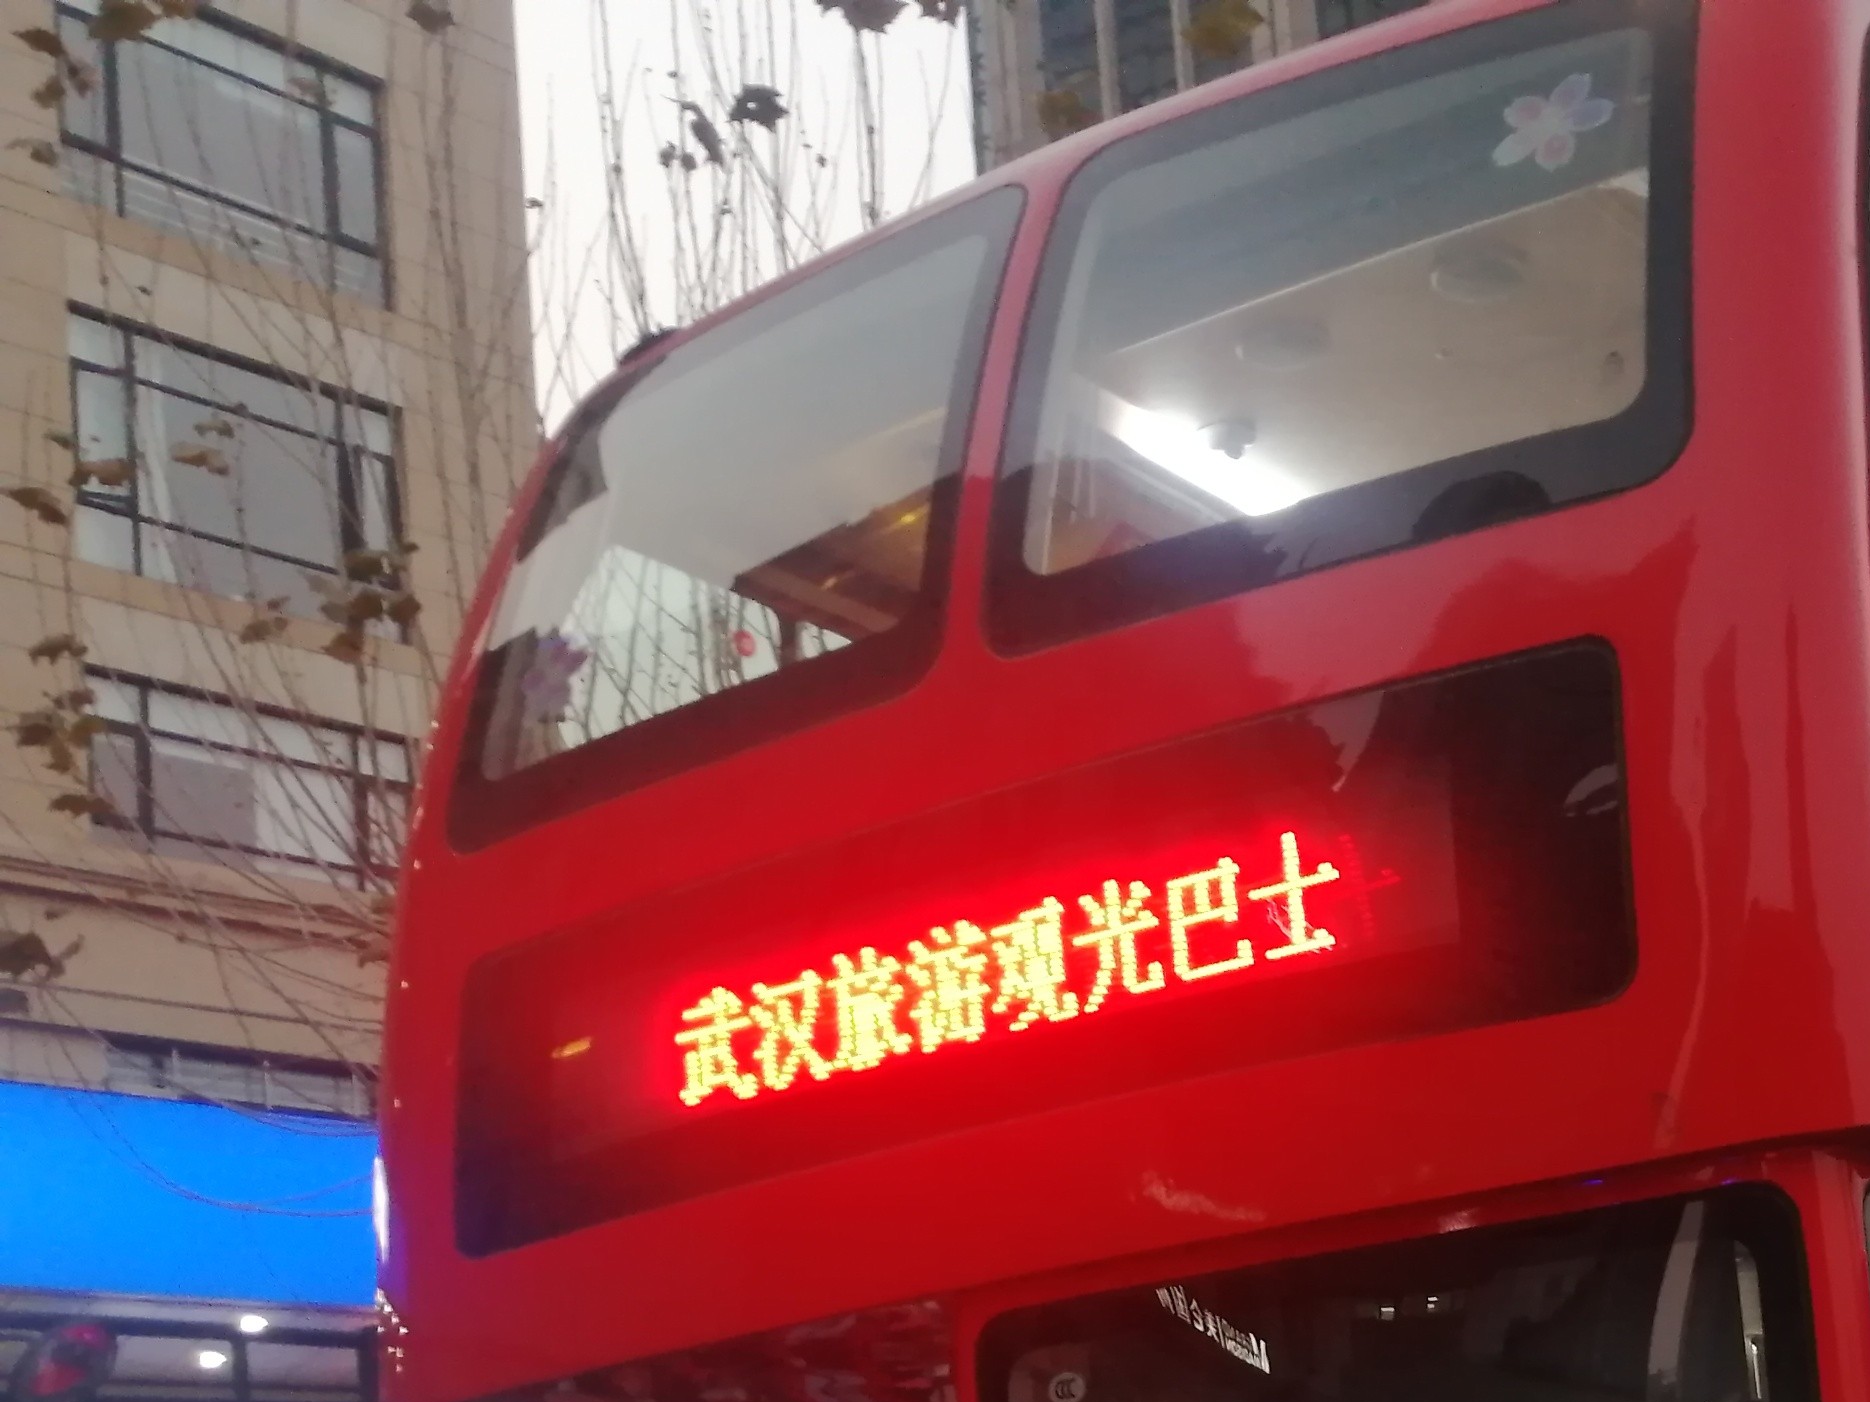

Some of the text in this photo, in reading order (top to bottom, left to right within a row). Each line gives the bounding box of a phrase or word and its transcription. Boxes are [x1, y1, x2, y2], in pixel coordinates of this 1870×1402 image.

[675, 832, 1339, 1105] 武汉旅游观光巴士
